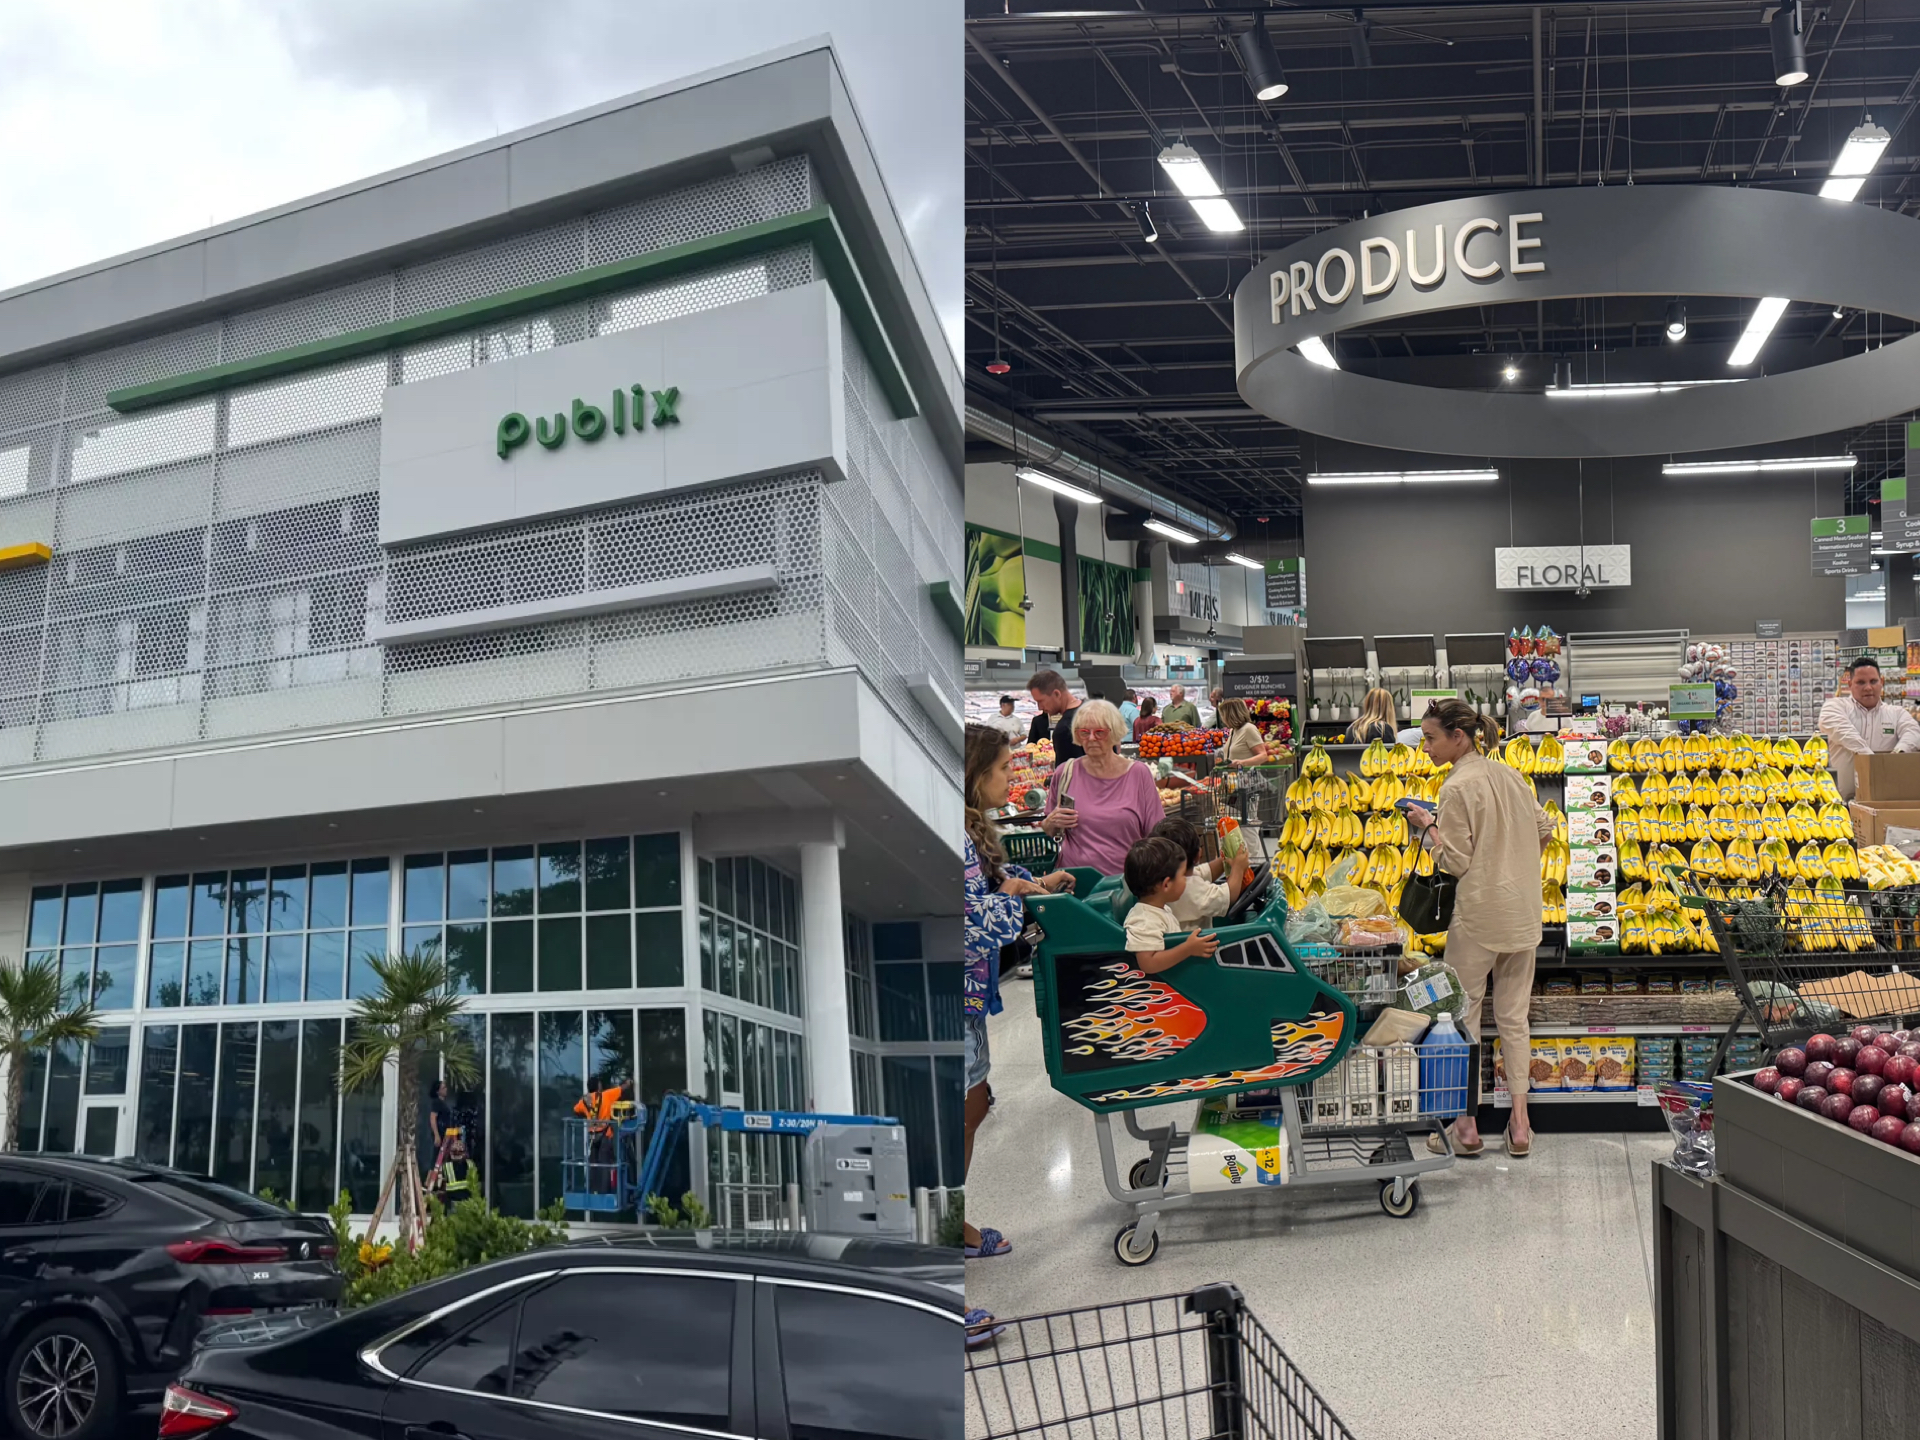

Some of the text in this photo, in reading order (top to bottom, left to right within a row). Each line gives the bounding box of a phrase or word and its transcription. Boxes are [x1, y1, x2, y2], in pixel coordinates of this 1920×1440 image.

[1270, 212, 1546, 324] PRODUCE
[1836, 519, 1846, 533] 3
[1278, 560, 1284, 572] 4
[1516, 563, 1610, 587] FLORAL
[1249, 675, 1270, 684] 3/$12
[1224, 1154, 1241, 1184] Bounty
